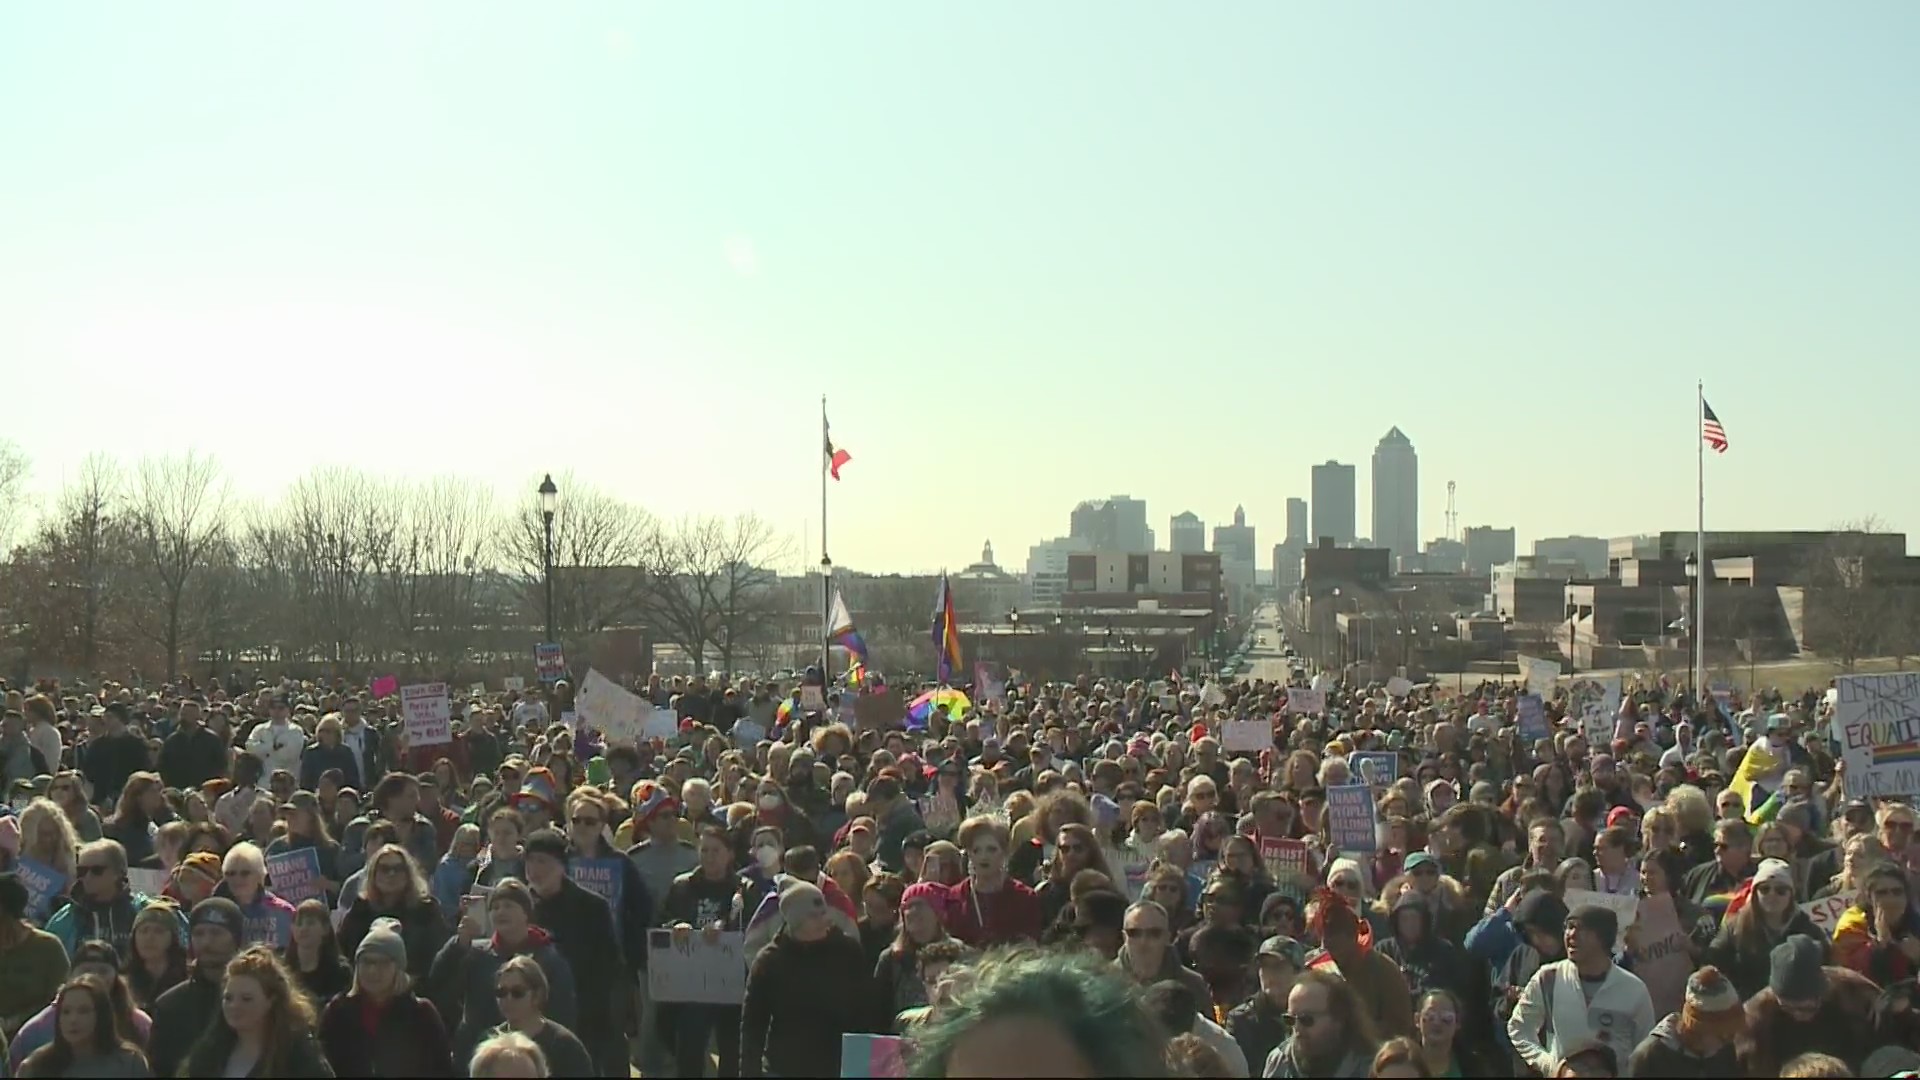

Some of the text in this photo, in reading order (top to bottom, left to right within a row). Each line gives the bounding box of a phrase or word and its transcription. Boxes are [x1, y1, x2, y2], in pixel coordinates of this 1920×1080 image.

[1845, 716, 1920, 749] EQUALI
[1329, 792, 1363, 804] TRANS
[1330, 804, 1368, 817] PEOPLE
[1331, 817, 1371, 830] BELONG
[1264, 847, 1304, 860] RESIST
[271, 856, 308, 875] TRANS
[574, 866, 611, 881] TRANS
